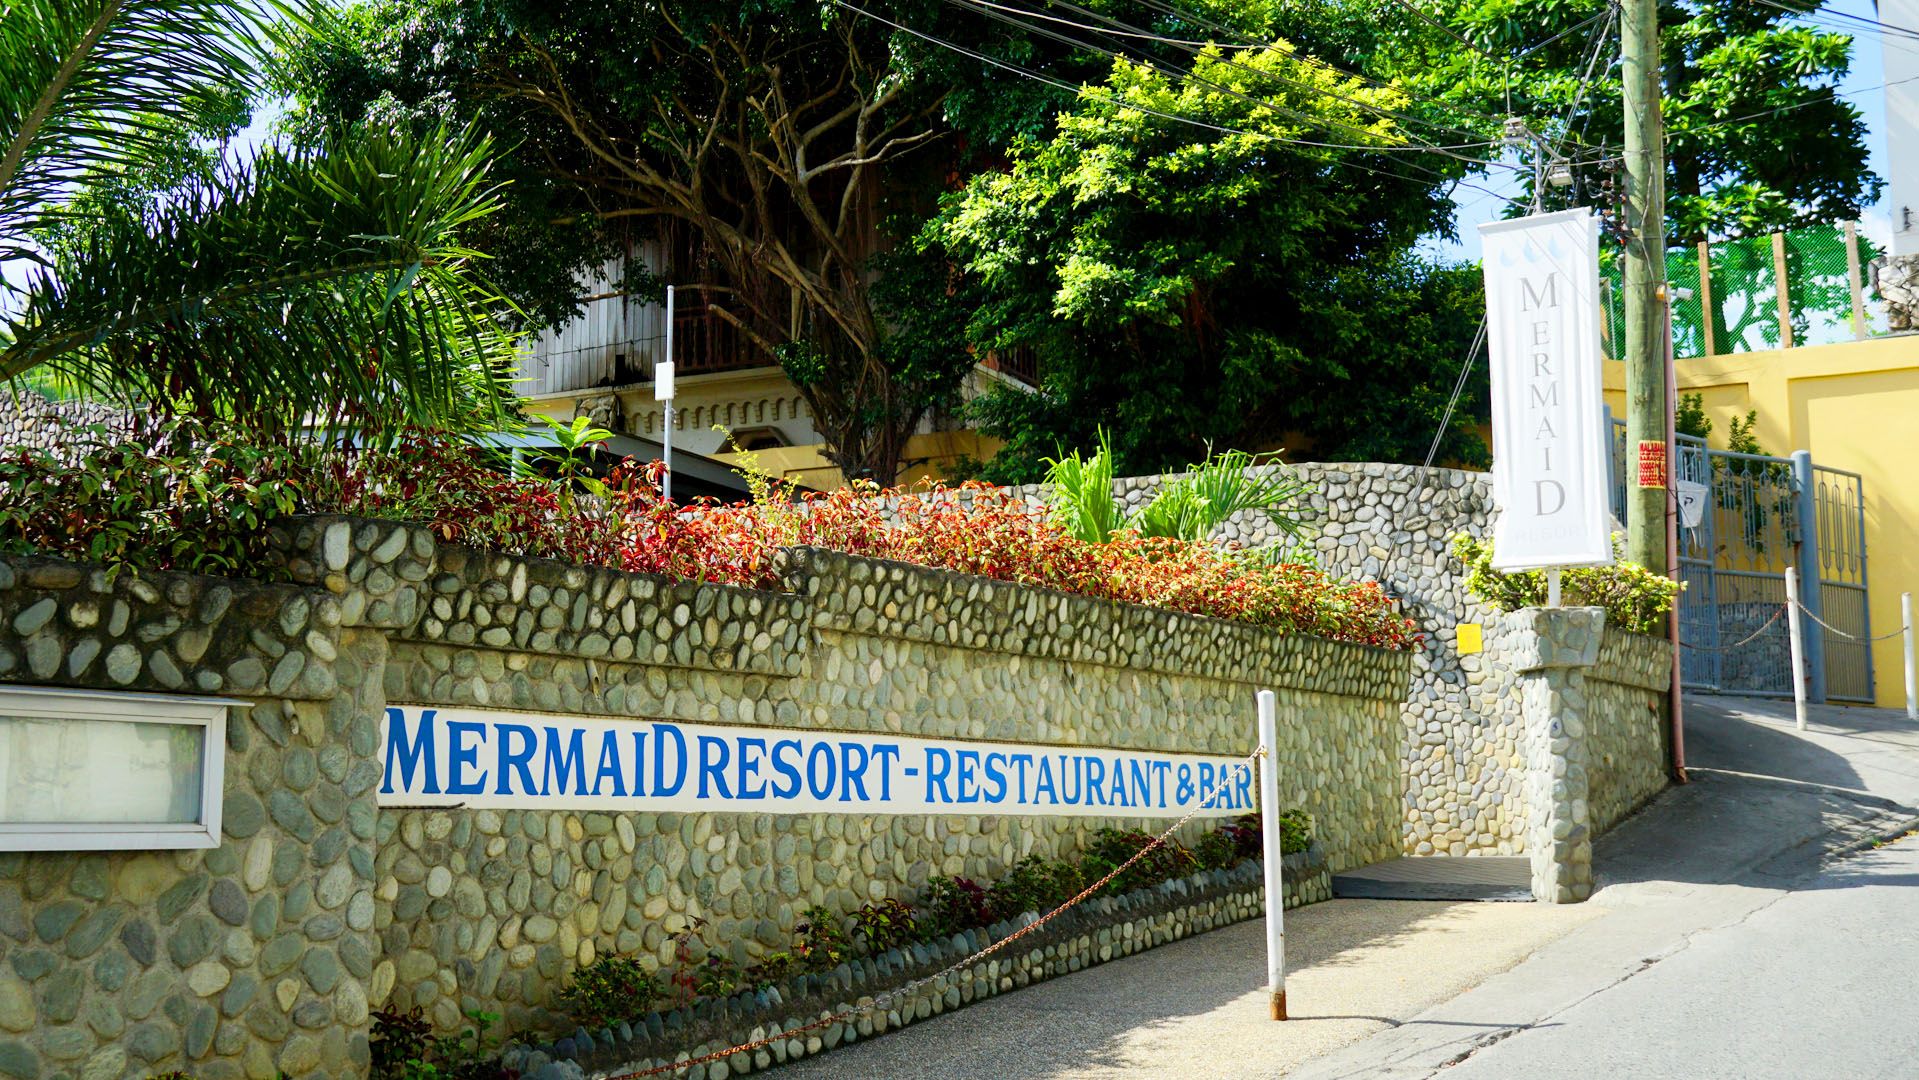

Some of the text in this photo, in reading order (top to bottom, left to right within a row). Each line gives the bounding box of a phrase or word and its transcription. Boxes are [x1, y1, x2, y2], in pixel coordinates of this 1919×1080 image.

[1519, 271, 1566, 517] MERMAID
[379, 707, 688, 797] MERMAID
[1197, 762, 1253, 809] BAR
